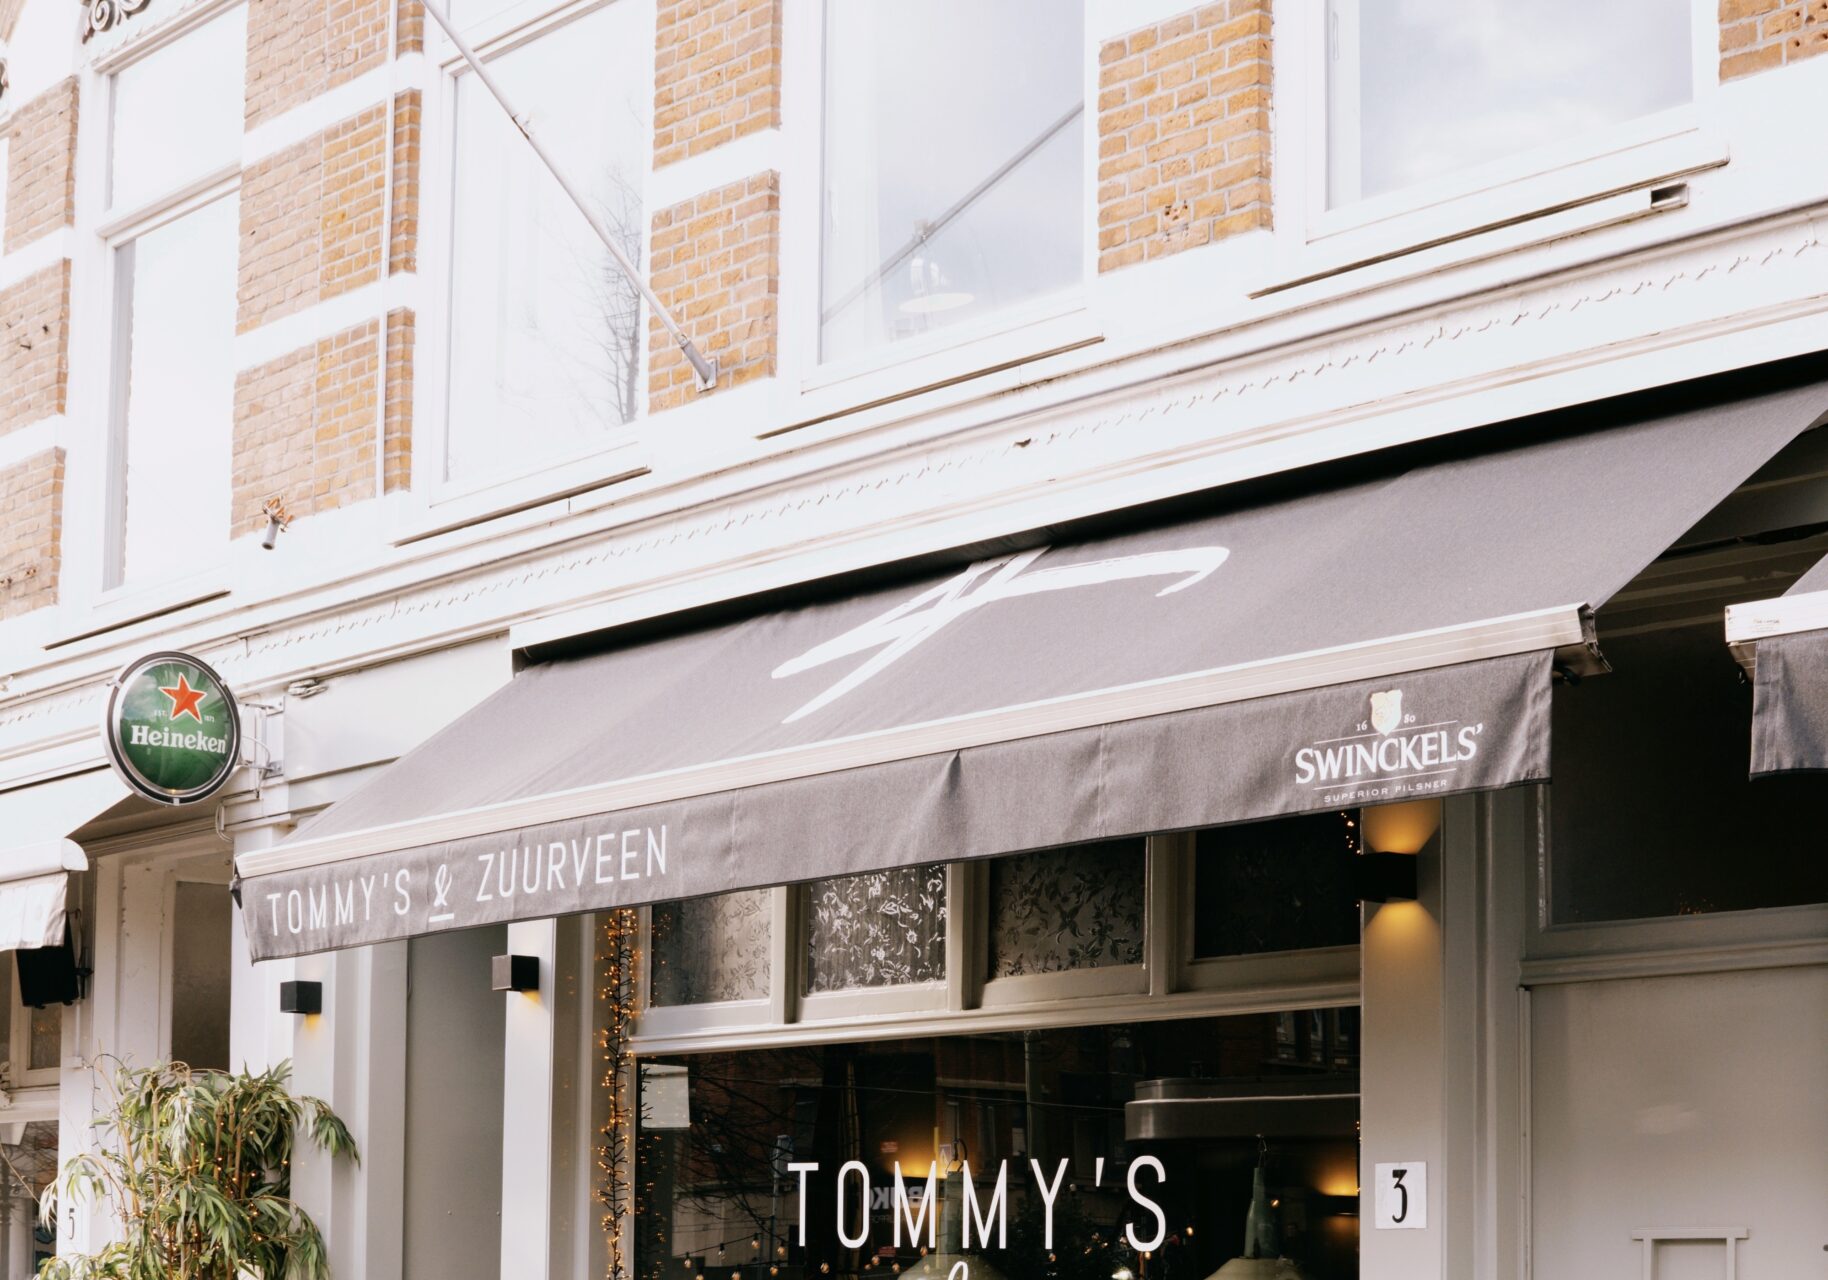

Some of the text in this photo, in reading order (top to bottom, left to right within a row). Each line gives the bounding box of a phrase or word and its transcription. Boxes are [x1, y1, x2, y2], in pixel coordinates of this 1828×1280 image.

[129, 725, 227, 754] Heineken
[1356, 720, 1368, 732] 16
[1295, 723, 1484, 785] SWINCKELS'
[1324, 778, 1448, 803] SUPERIOR PILSNER
[266, 824, 668, 937] TOMMY'S & ZUURVEEN
[786, 1154, 1167, 1253] TOMMY'S
[1392, 1168, 1408, 1224] 3
[68, 1207, 75, 1240] 5
